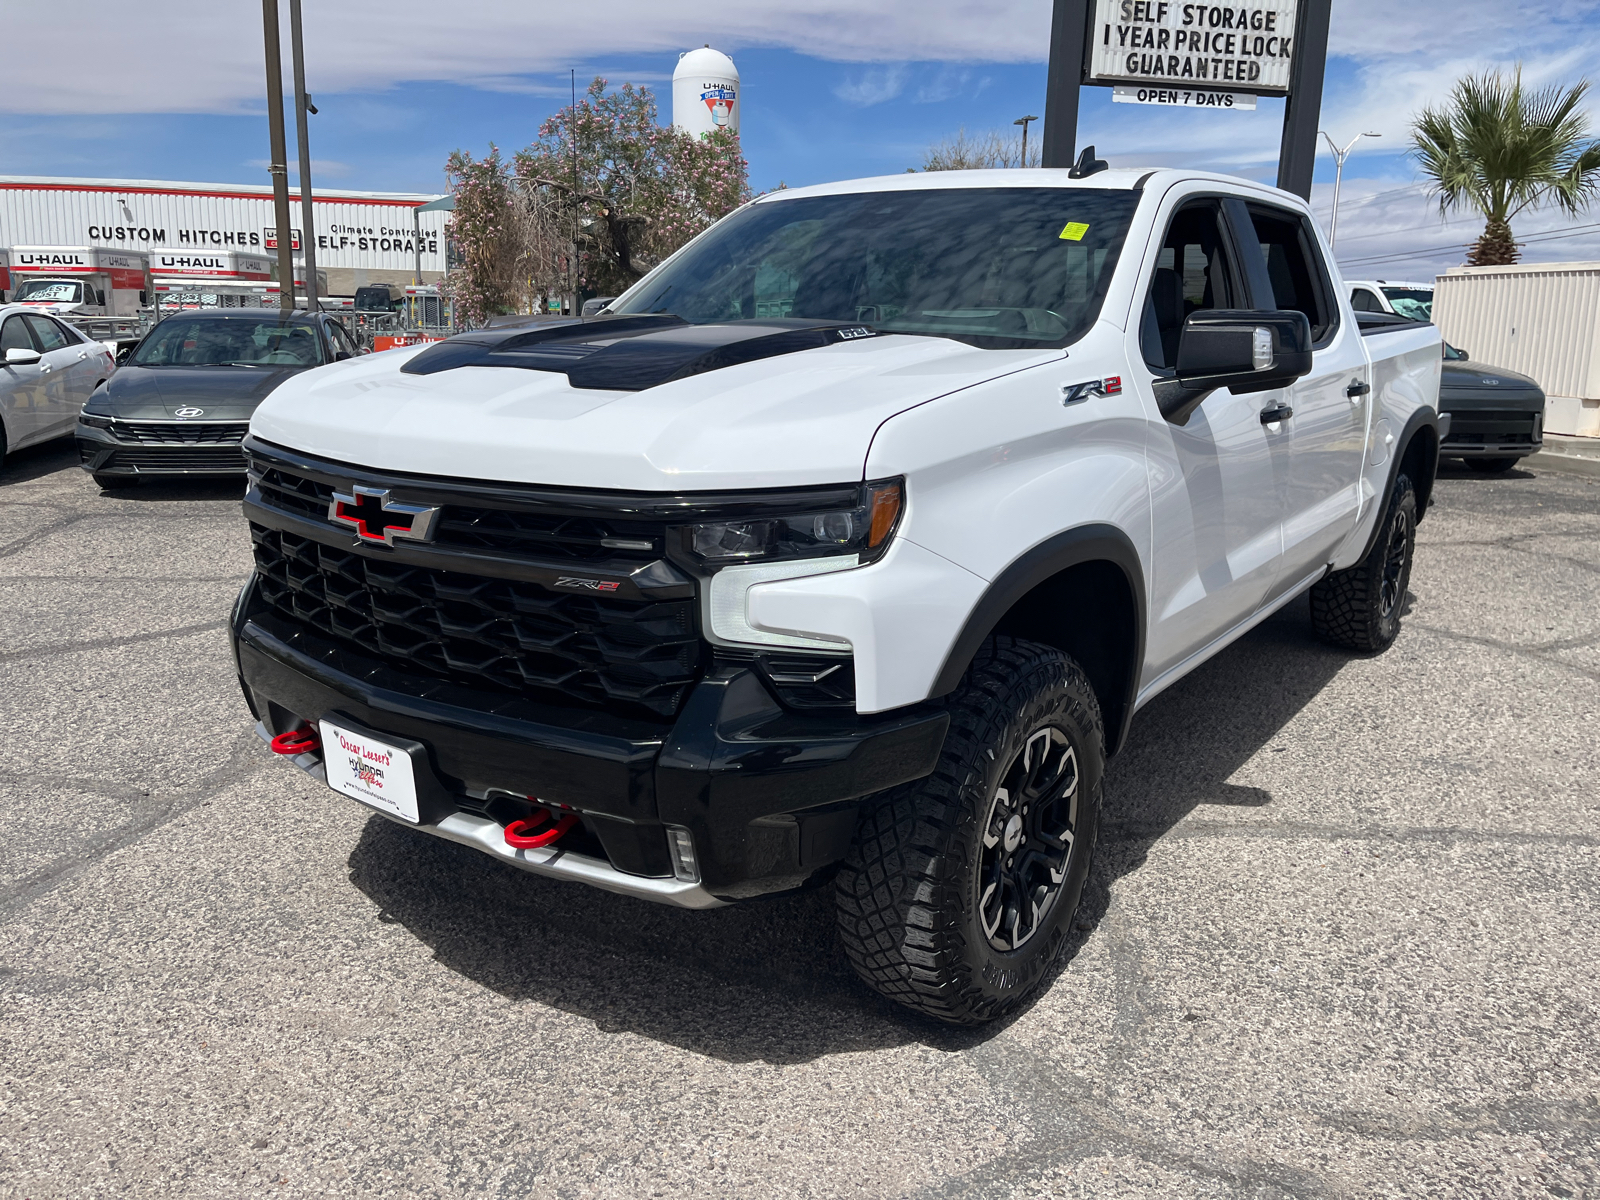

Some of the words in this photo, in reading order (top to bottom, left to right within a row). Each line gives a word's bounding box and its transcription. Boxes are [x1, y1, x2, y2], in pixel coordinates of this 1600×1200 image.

[1121, 0, 1168, 23] SELF
[1182, 4, 1277, 32] STORAGE
[1117, 25, 1170, 49] YEAR
[1175, 30, 1236, 55] PRICE
[1241, 35, 1292, 58] LOCK
[1126, 52, 1261, 81] GUARANTEED
[703, 83, 734, 91] U-HAUL
[1137, 89, 1178, 104] OPEN
[1183, 92, 1191, 105] 7
[1196, 93, 1233, 107] DAYS
[88, 226, 165, 242] CUSTOM
[179, 229, 260, 245] HITCHES
[331, 224, 373, 235] Climate
[380, 227, 437, 238] Controled
[313, 234, 437, 253] ELF-STORAGE
[20, 254, 84, 265] U-HAUL
[161, 257, 224, 268] U-HAUL
[1063, 376, 1122, 405] ZR2
[554, 576, 620, 592] ZR2
[340, 735, 361, 755] Oscar
[362, 745, 390, 767] Leeser's
[348, 757, 385, 779] HYUNDAI
